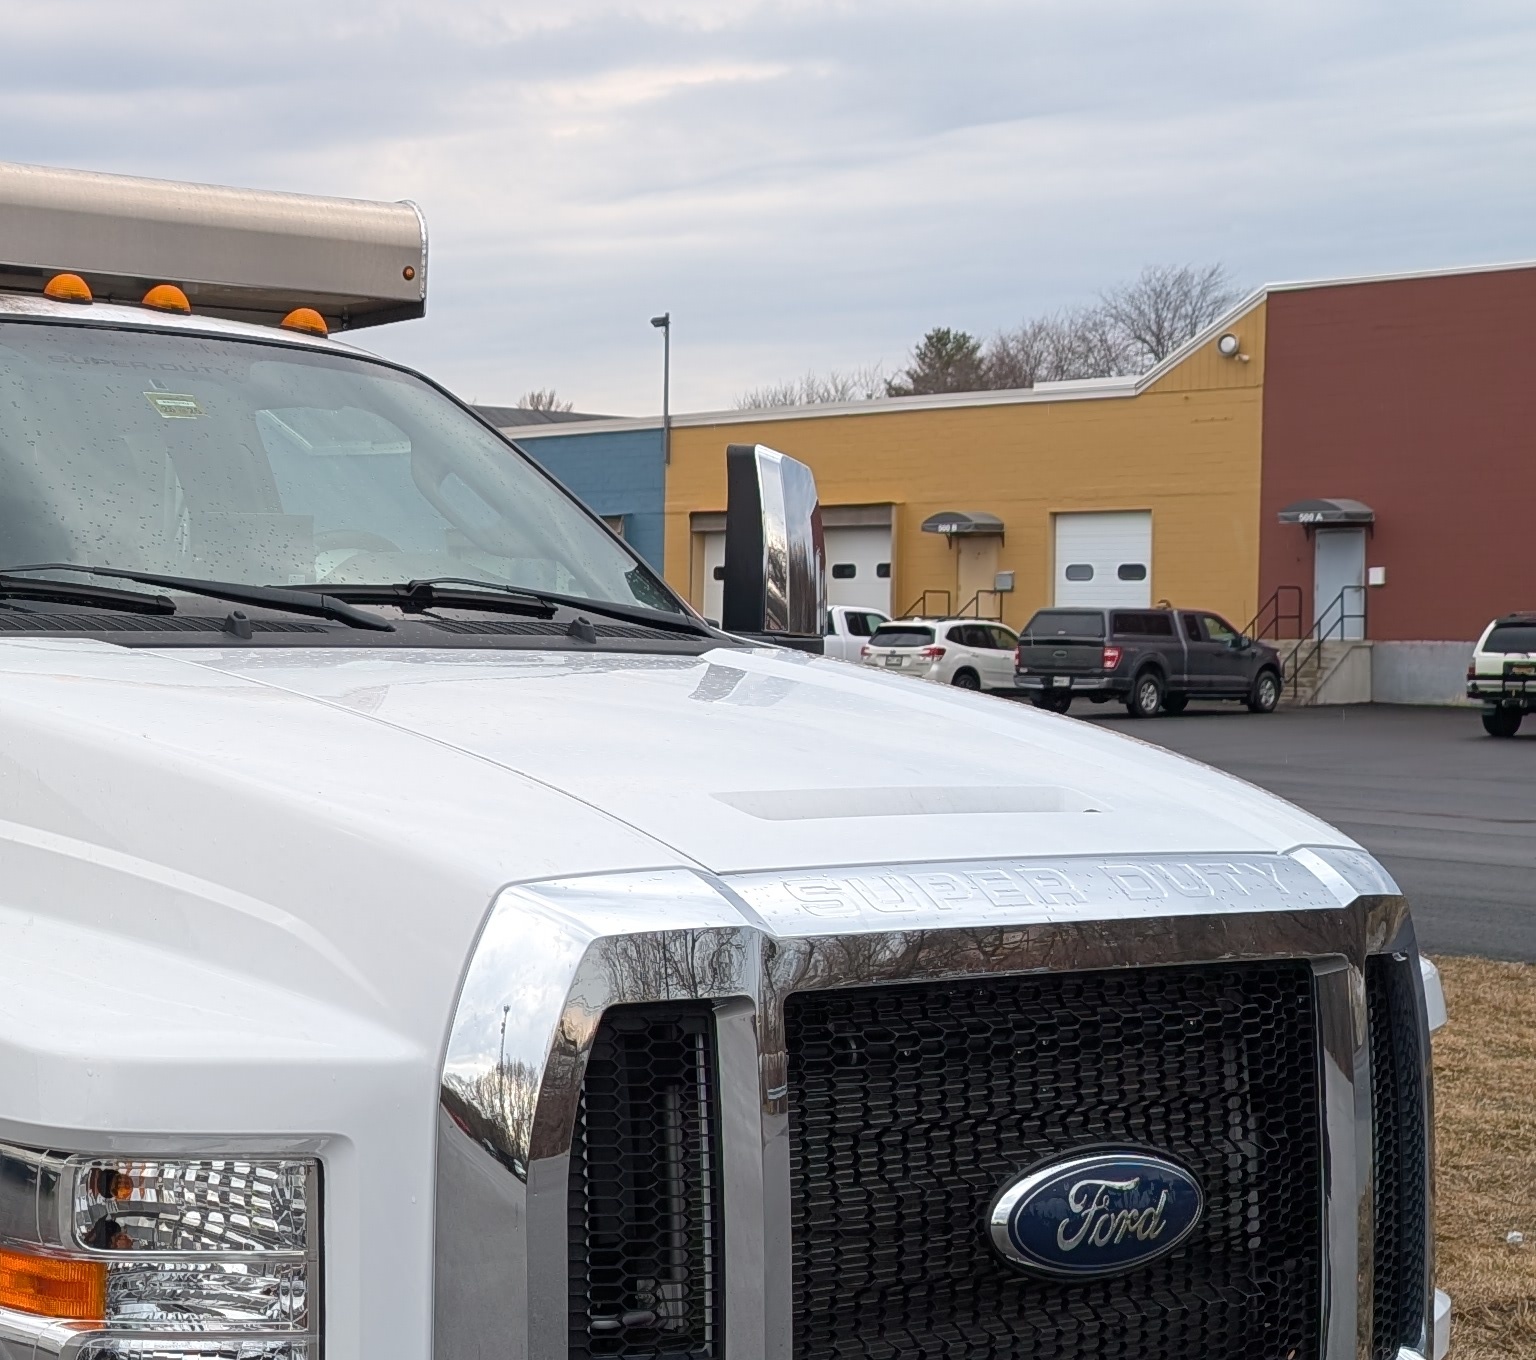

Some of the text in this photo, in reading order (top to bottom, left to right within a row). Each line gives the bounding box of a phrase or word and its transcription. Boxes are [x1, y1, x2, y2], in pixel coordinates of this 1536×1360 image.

[157, 362, 231, 375] DUTY
[780, 861, 1291, 919] SUPER DUTY
[1056, 1176, 1169, 1252] Ford
